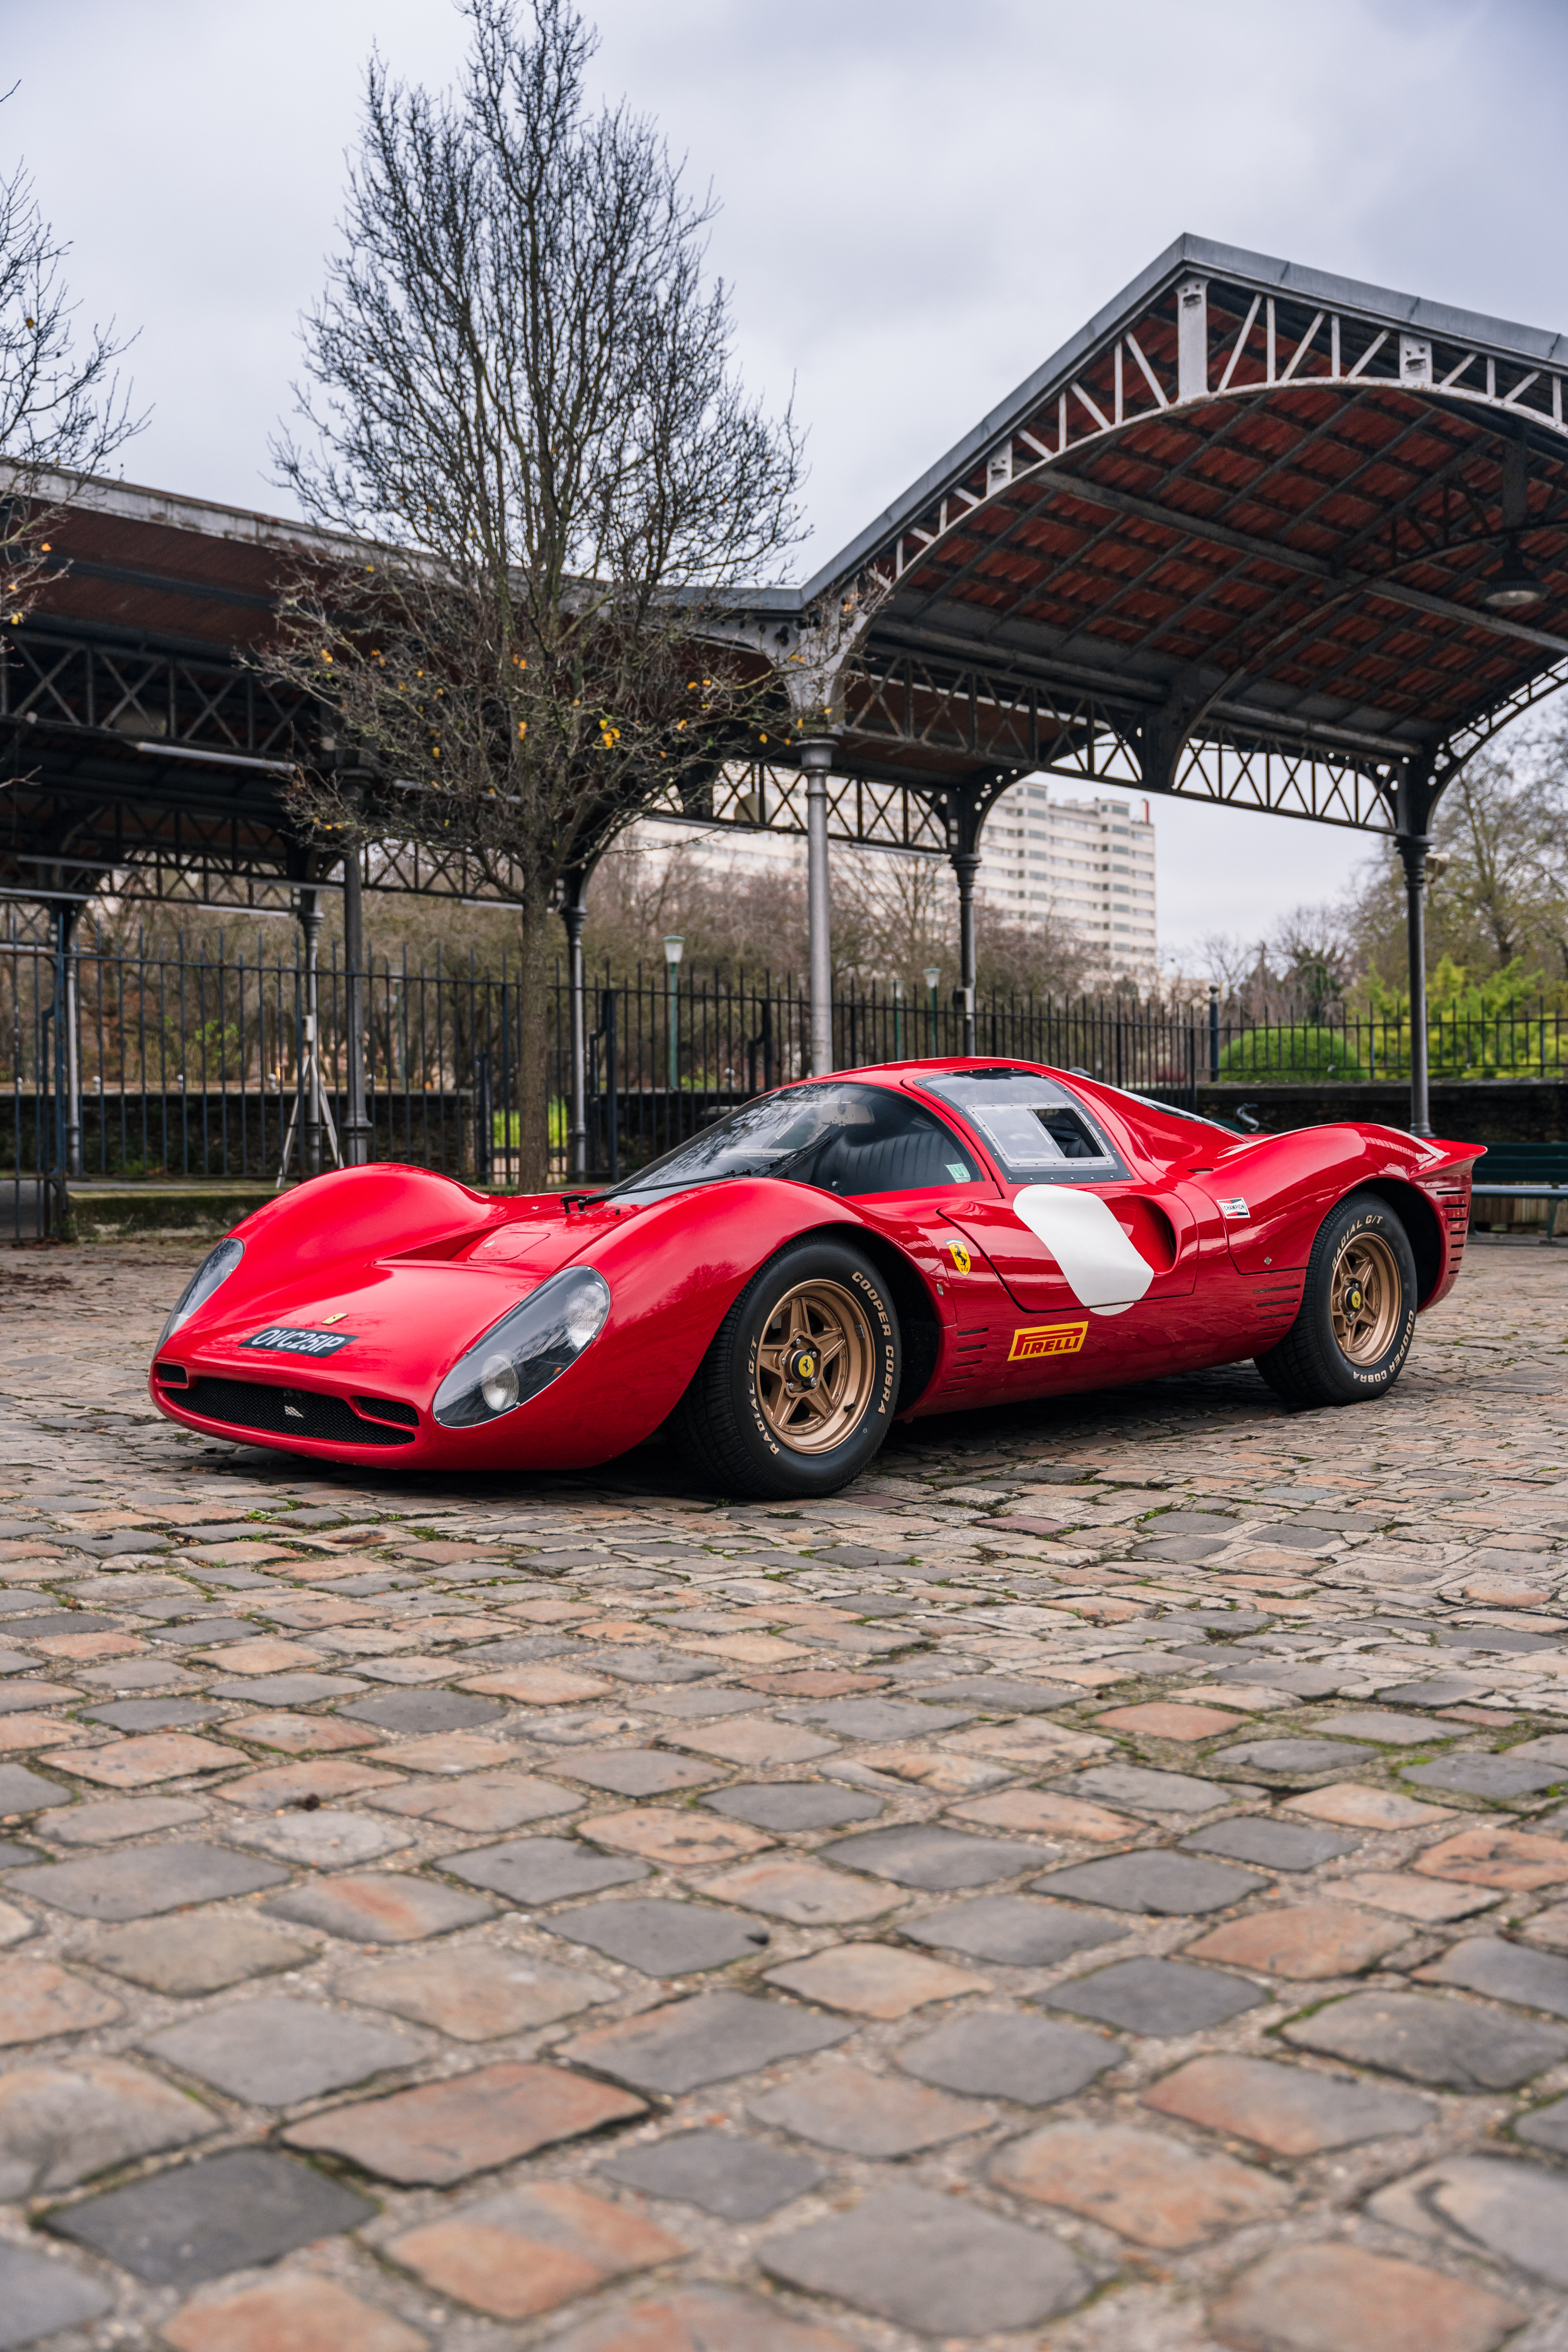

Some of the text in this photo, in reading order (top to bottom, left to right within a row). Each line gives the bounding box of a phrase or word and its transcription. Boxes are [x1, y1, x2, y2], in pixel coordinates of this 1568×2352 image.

[1332, 1215, 1383, 1271] RADIAL G/T
[252, 1329, 346, 1352] OVC251P
[852, 1271, 894, 1414] COOPER COBRA
[1013, 1327, 1083, 1357] PIRELLI
[1353, 1310, 1414, 1383] COOPER COBRA
[748, 1335, 780, 1455] RADIAL G/T
